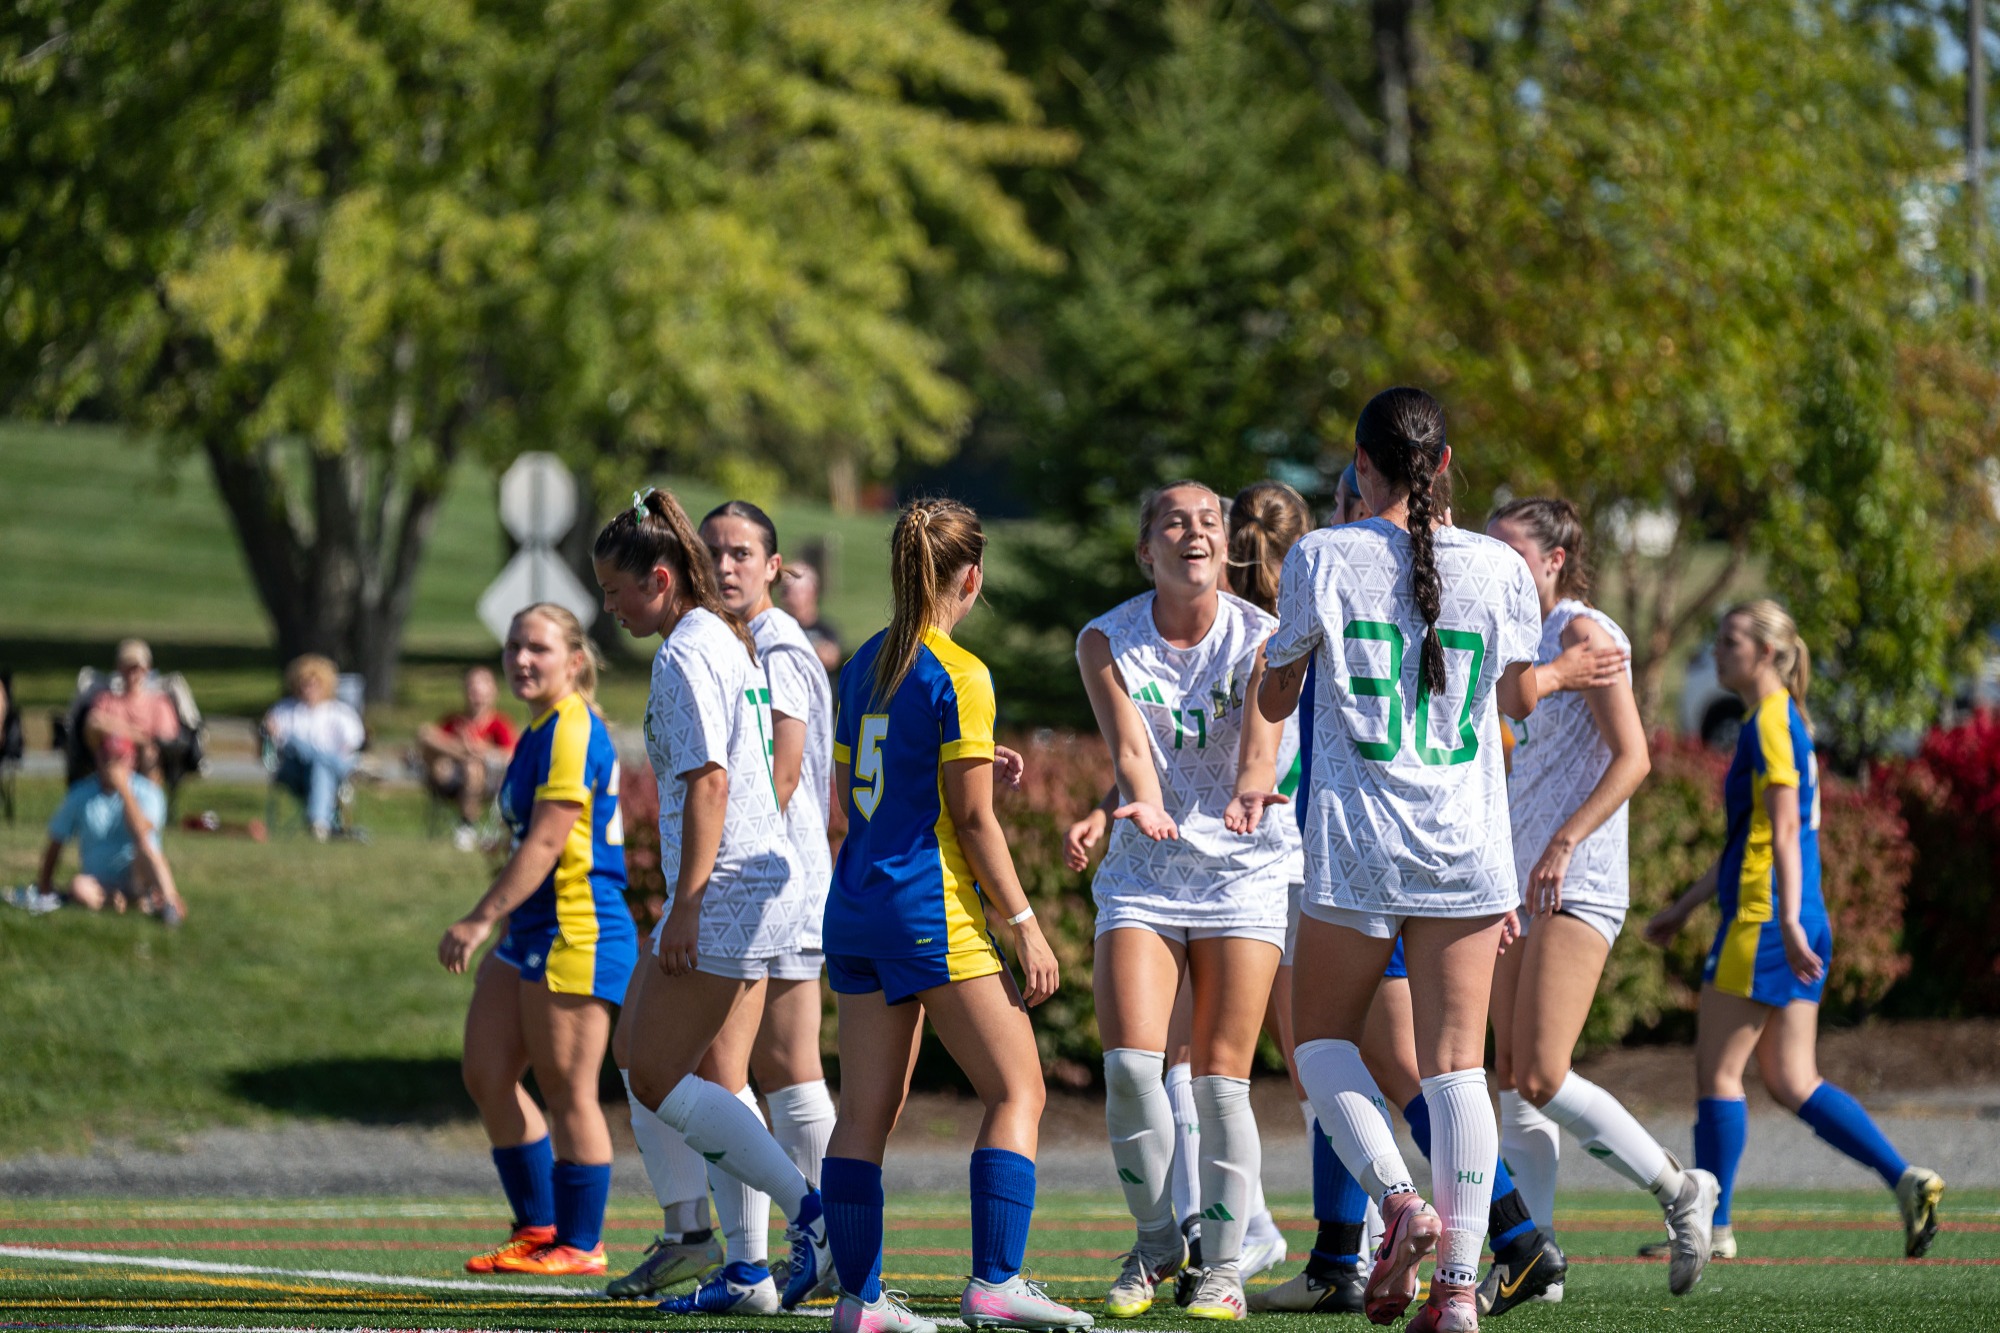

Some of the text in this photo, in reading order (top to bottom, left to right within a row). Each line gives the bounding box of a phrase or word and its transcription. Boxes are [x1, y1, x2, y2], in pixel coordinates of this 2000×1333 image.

[1172, 708, 1207, 749] 17
[1343, 620, 1485, 766] 30
[852, 713, 889, 822] 5
[1457, 1170, 1484, 1185] HU
